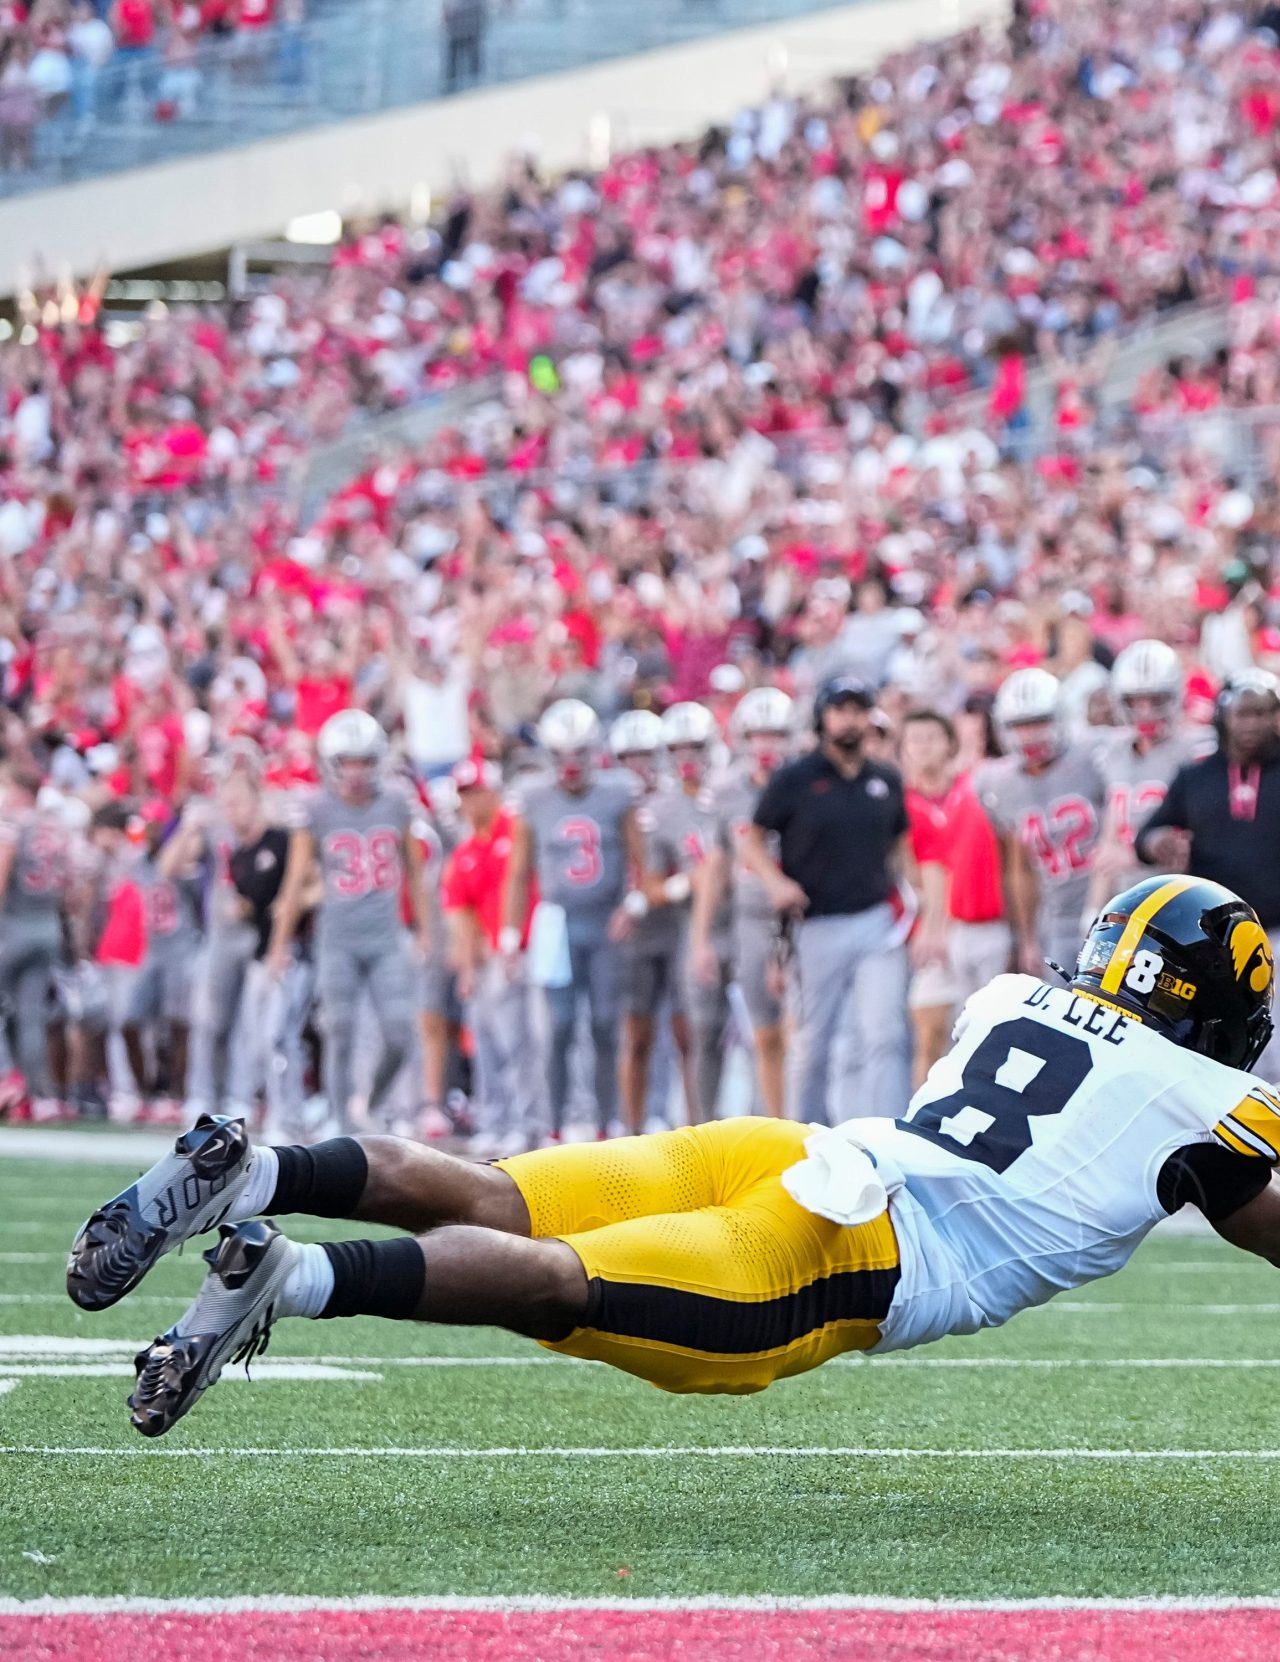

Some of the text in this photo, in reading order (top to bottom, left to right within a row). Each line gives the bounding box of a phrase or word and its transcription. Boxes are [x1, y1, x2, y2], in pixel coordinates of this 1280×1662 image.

[324, 828, 401, 898] 38
[557, 816, 603, 887] 3
[1022, 795, 1098, 882] 42
[1125, 949, 1164, 994] 8
[1062, 996, 1128, 1045] LEE
[895, 1016, 1093, 1175] 8
